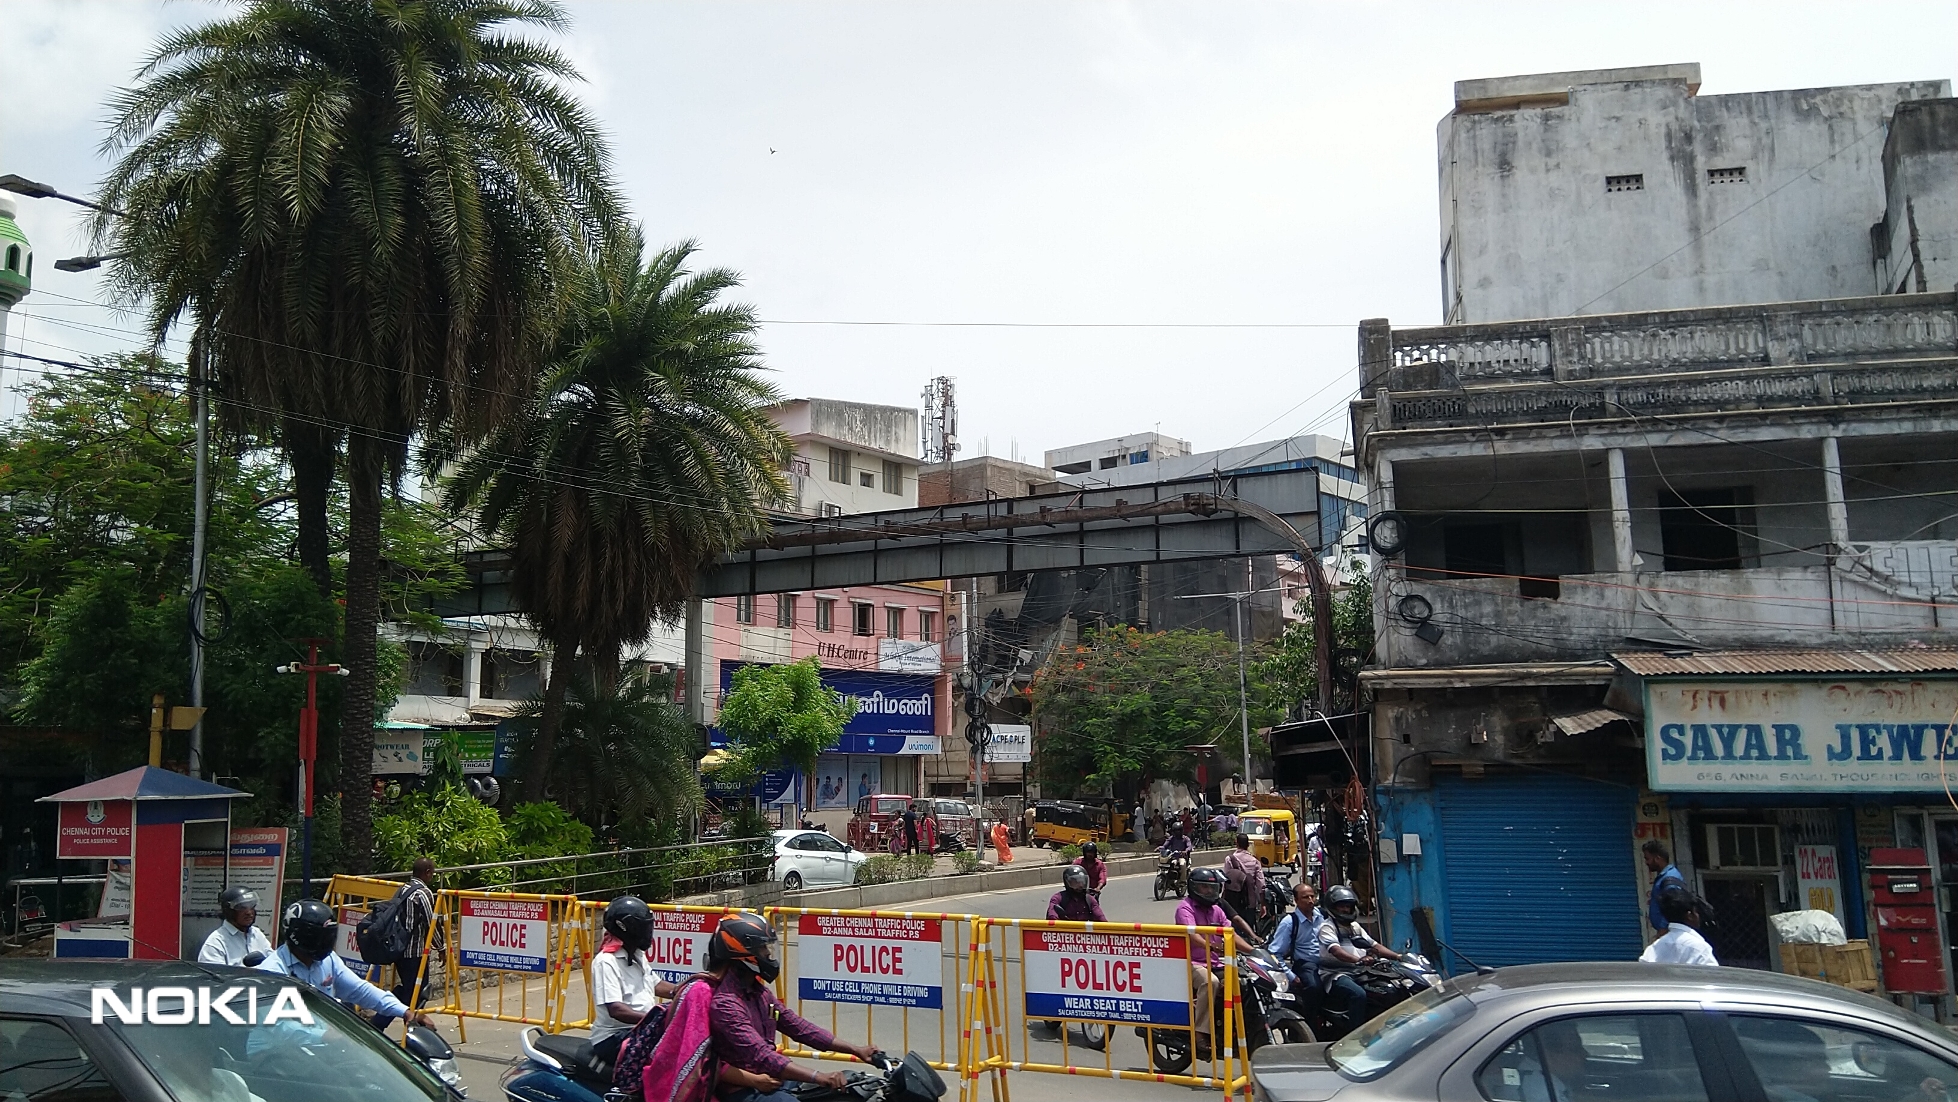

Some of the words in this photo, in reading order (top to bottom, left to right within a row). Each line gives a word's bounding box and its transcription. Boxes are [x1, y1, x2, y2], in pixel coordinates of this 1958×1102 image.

[1660, 724, 1808, 762] SAYAR
[1826, 724, 1958, 762] JEWE
[1730, 773, 1769, 781] ANNA
[62, 828, 90, 836] CHENNAI
[91, 828, 105, 836] CITY
[106, 828, 130, 836] POLICE
[1799, 848, 1810, 880] 22
[1812, 848, 1836, 880] Carat
[470, 900, 489, 909] GREATER
[490, 901, 508, 910] CHENNAI
[509, 902, 527, 911] TRAFFIC
[528, 903, 543, 912] POLICE
[1808, 886, 1836, 914] GOLD
[509, 910, 530, 919] TRAFFIC
[663, 913, 685, 923] TRAFFIC
[686, 914, 705, 924] POLICE
[665, 922, 690, 931] TRAFFIC
[691, 923, 700, 931] P.S
[817, 916, 845, 927] GREATER
[846, 917, 874, 928] CHENNAI
[875, 918, 901, 929] TRAFFIC
[902, 920, 925, 931] POLICE
[482, 920, 527, 949] POLICE
[822, 926, 853, 936] D2-ANNA
[854, 928, 875, 936] SALAI
[877, 929, 907, 938] TRAFFIC
[909, 930, 920, 939] P.S
[1042, 932, 1075, 944] GREATER
[1076, 933, 1108, 945] CHENNAI
[1109, 935, 1140, 947] TRAFFIC
[1142, 937, 1169, 948] POLICE
[645, 936, 692, 965] OLICE
[1048, 943, 1084, 953] D2-ANNA
[1086, 945, 1110, 955] SALAI
[1112, 946, 1148, 956] TRAFFIC
[1150, 948, 1163, 957] P.S
[496, 954, 509, 963] PHONE
[833, 943, 903, 976] POLICE
[668, 972, 674, 981] &
[1060, 957, 1142, 993] POLICE
[813, 979, 831, 990] DON'T
[831, 981, 844, 991] USE
[844, 982, 859, 993] CELL
[861, 982, 882, 994] PHONE
[883, 984, 902, 996] WHILE
[903, 986, 928, 998] DRIVING
[1064, 997, 1092, 1010] WEAR
[1094, 998, 1119, 1011] SEAT
[1120, 1000, 1143, 1013] BELT
